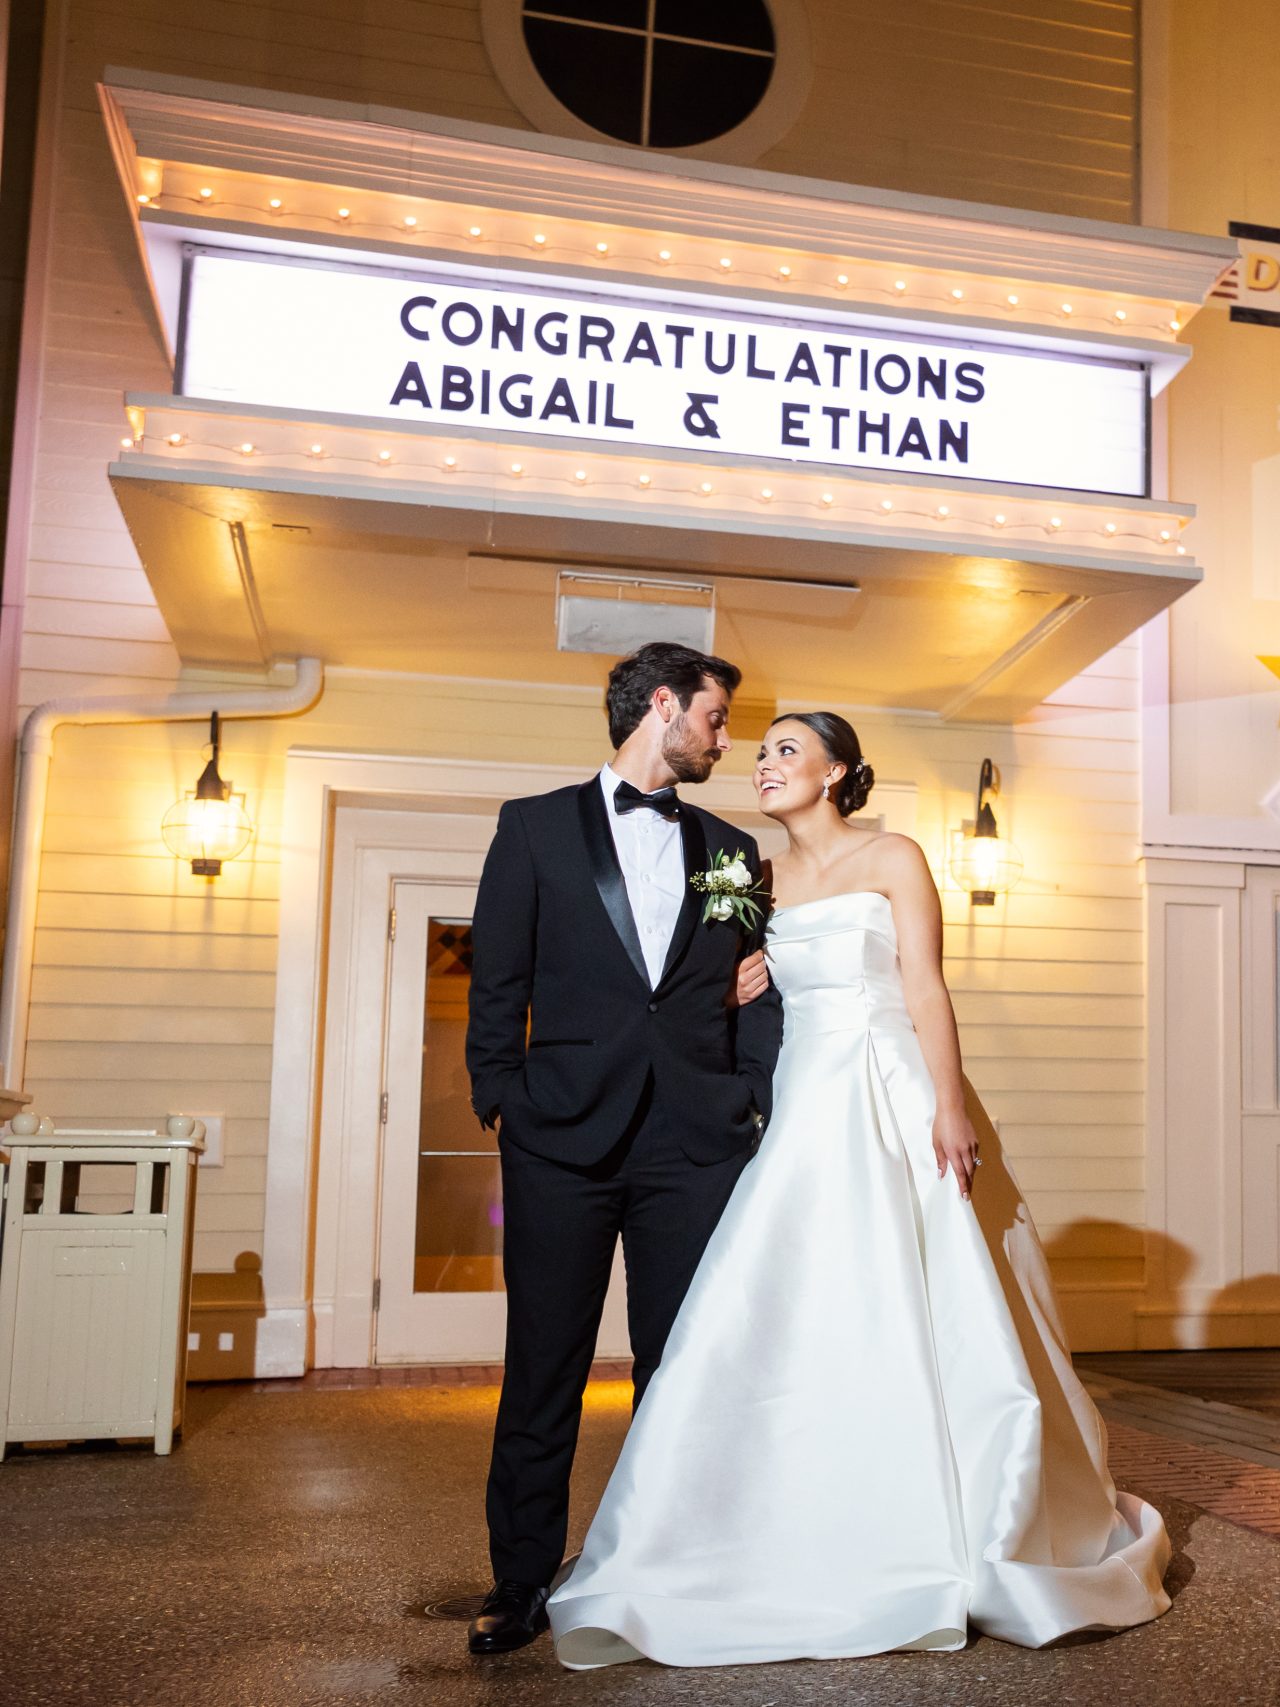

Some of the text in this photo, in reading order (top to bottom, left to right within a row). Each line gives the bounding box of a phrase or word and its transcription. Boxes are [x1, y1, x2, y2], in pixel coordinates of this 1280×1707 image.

[400, 295, 985, 404] CONGRATULATIONS
[389, 361, 969, 464] ABIGAIL & ETHAN
